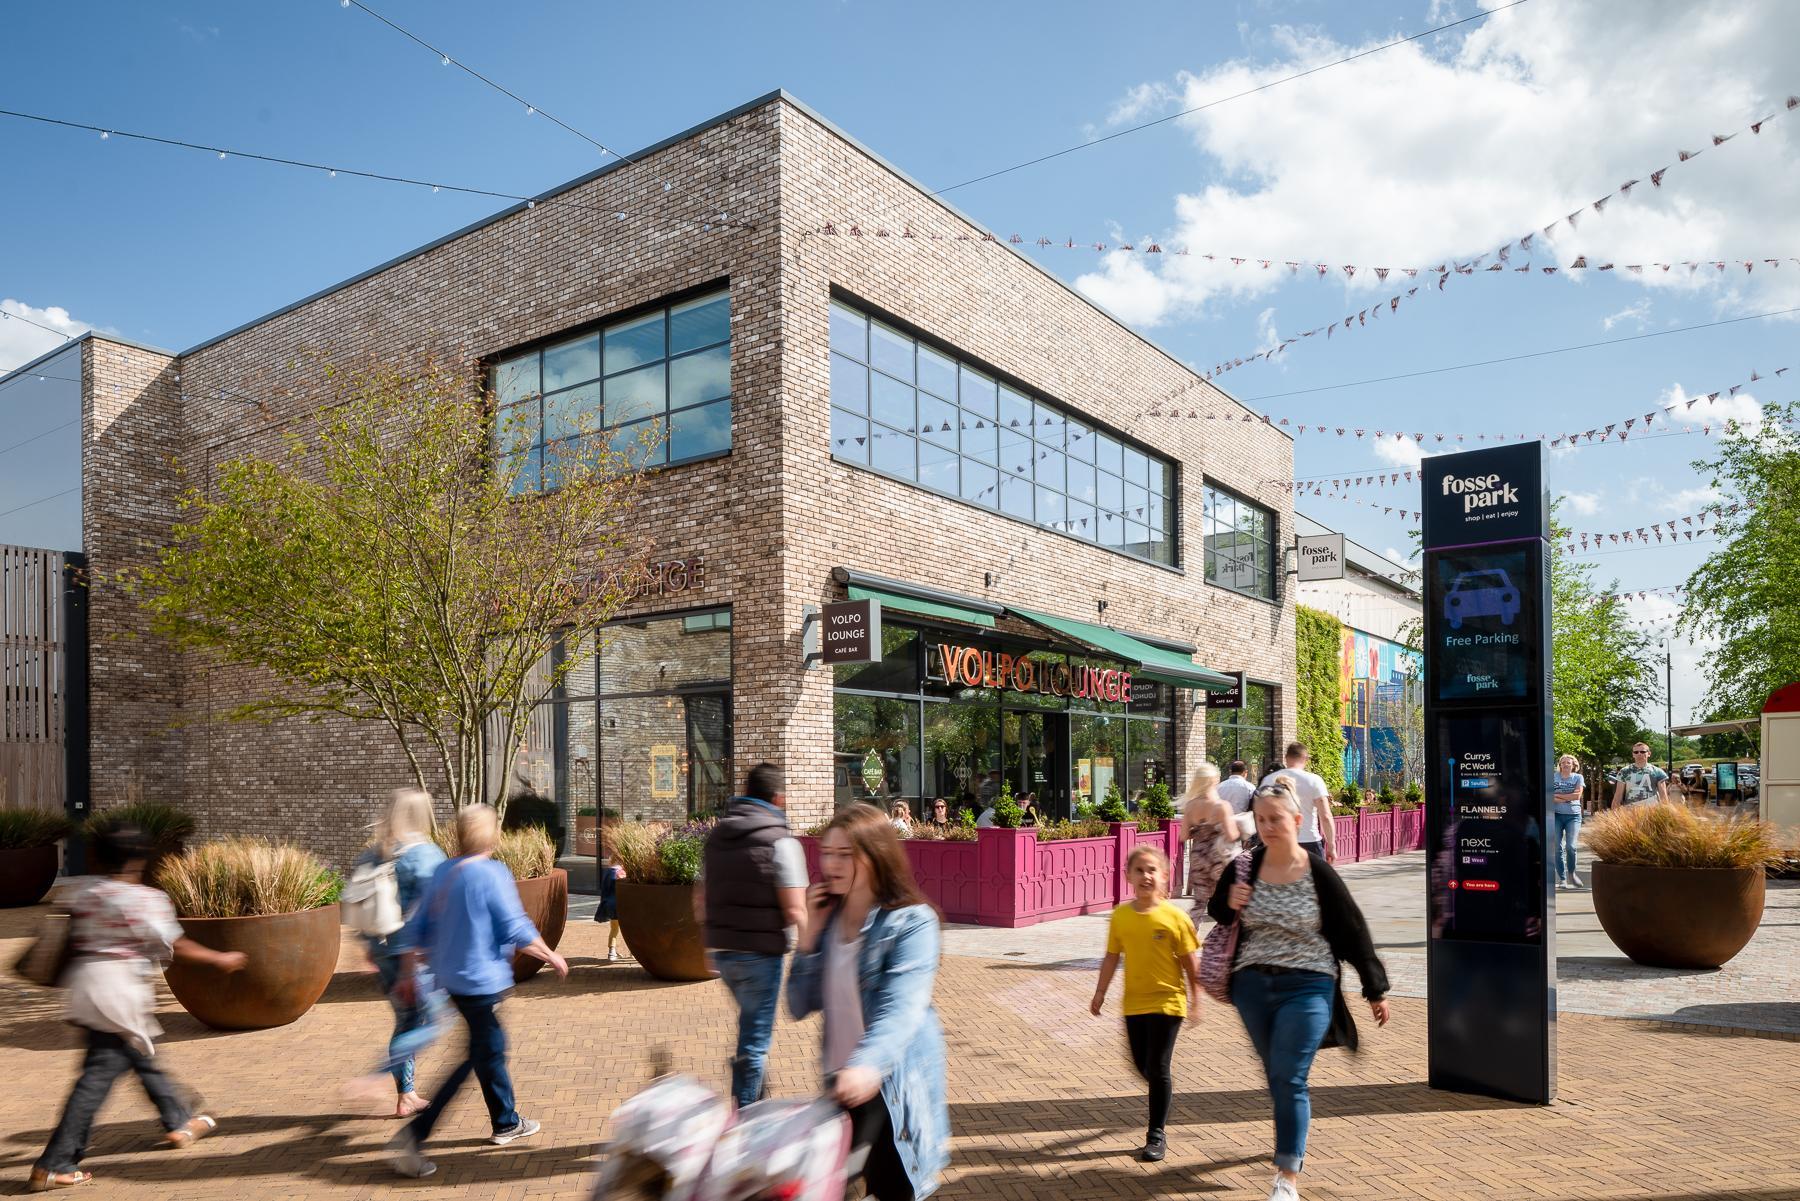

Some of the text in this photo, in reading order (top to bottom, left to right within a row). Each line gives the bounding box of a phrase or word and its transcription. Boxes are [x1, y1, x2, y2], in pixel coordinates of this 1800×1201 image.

[1442, 474, 1500, 495] fosse
[1464, 482, 1519, 513] park
[1501, 510, 1519, 518] enjoy
[1302, 545, 1329, 556] fosse
[1312, 552, 1337, 565] park
[832, 614, 861, 624] VOLPO
[828, 629, 864, 640] LOUNGE
[1446, 632, 1519, 646] Free Parking
[938, 644, 1133, 704] VOLPO LOUNGE
[1467, 674, 1491, 683] fosse
[1476, 680, 1498, 691] park
[1464, 753, 1491, 761] Currys
[1460, 805, 1507, 813] FLANNELS
[1461, 838, 1491, 847] next
